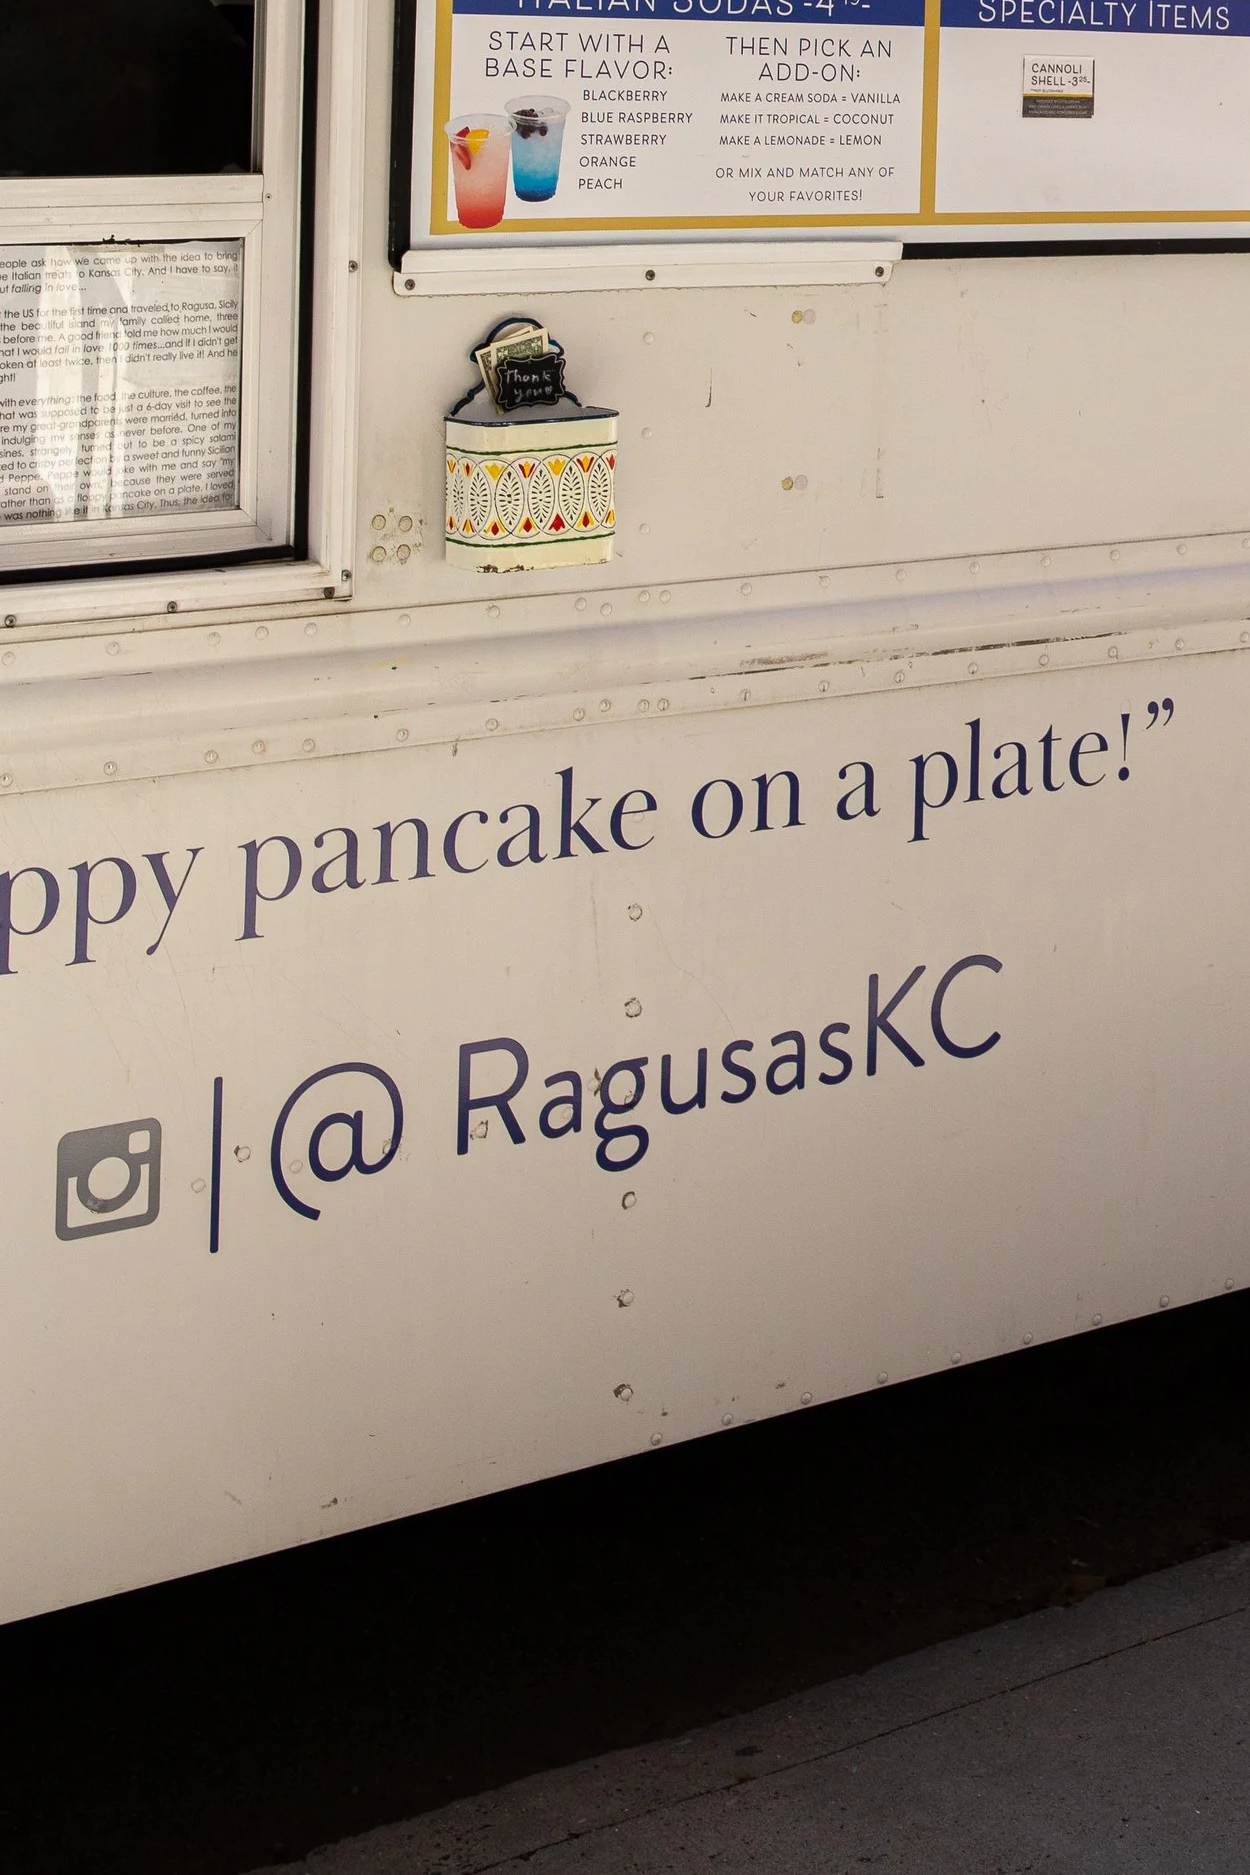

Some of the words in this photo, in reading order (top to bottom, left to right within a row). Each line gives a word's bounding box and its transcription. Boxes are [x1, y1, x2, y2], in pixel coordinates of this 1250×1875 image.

[1150, 0, 1229, 30] ITEMS
[489, 31, 568, 51] START
[579, 33, 643, 53] WITH
[655, 35, 670, 53] A
[726, 37, 787, 56] THEN
[800, 38, 851, 57] PICK
[860, 40, 891, 58] AN
[486, 58, 552, 77] BASE
[565, 59, 672, 79] FLAVOR:
[759, 62, 859, 82] ADD-ON:
[1032, 63, 1081, 74] CANNOLI
[1031, 76, 1065, 86] SHELL
[583, 90, 667, 101] BLACKBERRY
[582, 112, 613, 123] BLUE
[619, 112, 692, 123] RASPBERRY
[581, 134, 666, 145] STRAWBERRY
[580, 156, 636, 167] ORANGE
[579, 178, 622, 189] PEACH
[141, 254, 160, 263] with
[181, 252, 201, 262] idea
[205, 252, 213, 261] to
[217, 251, 238, 262] bring
[148, 266, 167, 275] And
[175, 265, 199, 275] have
[202, 265, 211, 273] to
[219, 300, 239, 310] Sicily
[22, 309, 34, 318] US
[235, 767, 656, 941] pancake
[691, 768, 805, 839] on
[836, 759, 880, 820] a
